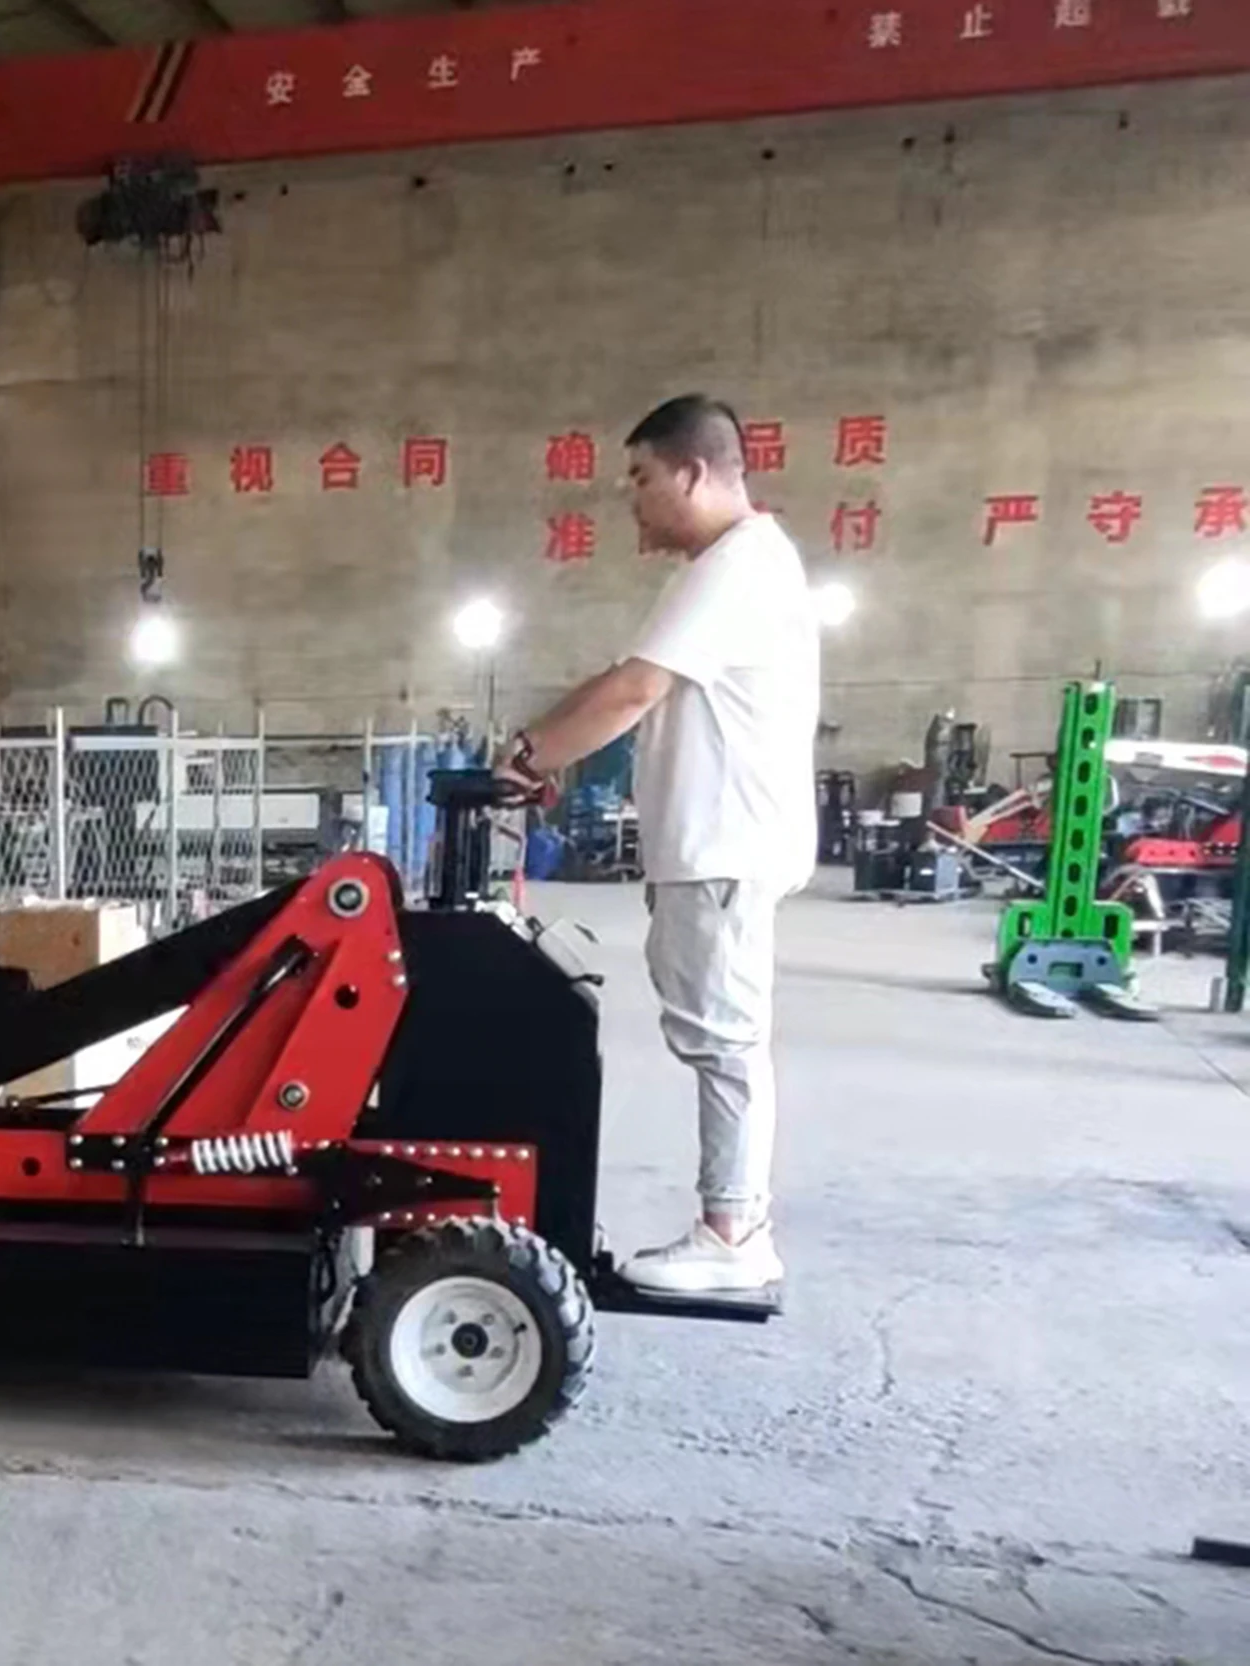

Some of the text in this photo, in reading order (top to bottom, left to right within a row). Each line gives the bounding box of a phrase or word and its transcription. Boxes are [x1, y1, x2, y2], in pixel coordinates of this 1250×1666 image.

[265, 47, 542, 105] 安全生产
[145, 415, 887, 496] 重视合同 确品质
[982, 487, 1248, 546] 严守承
